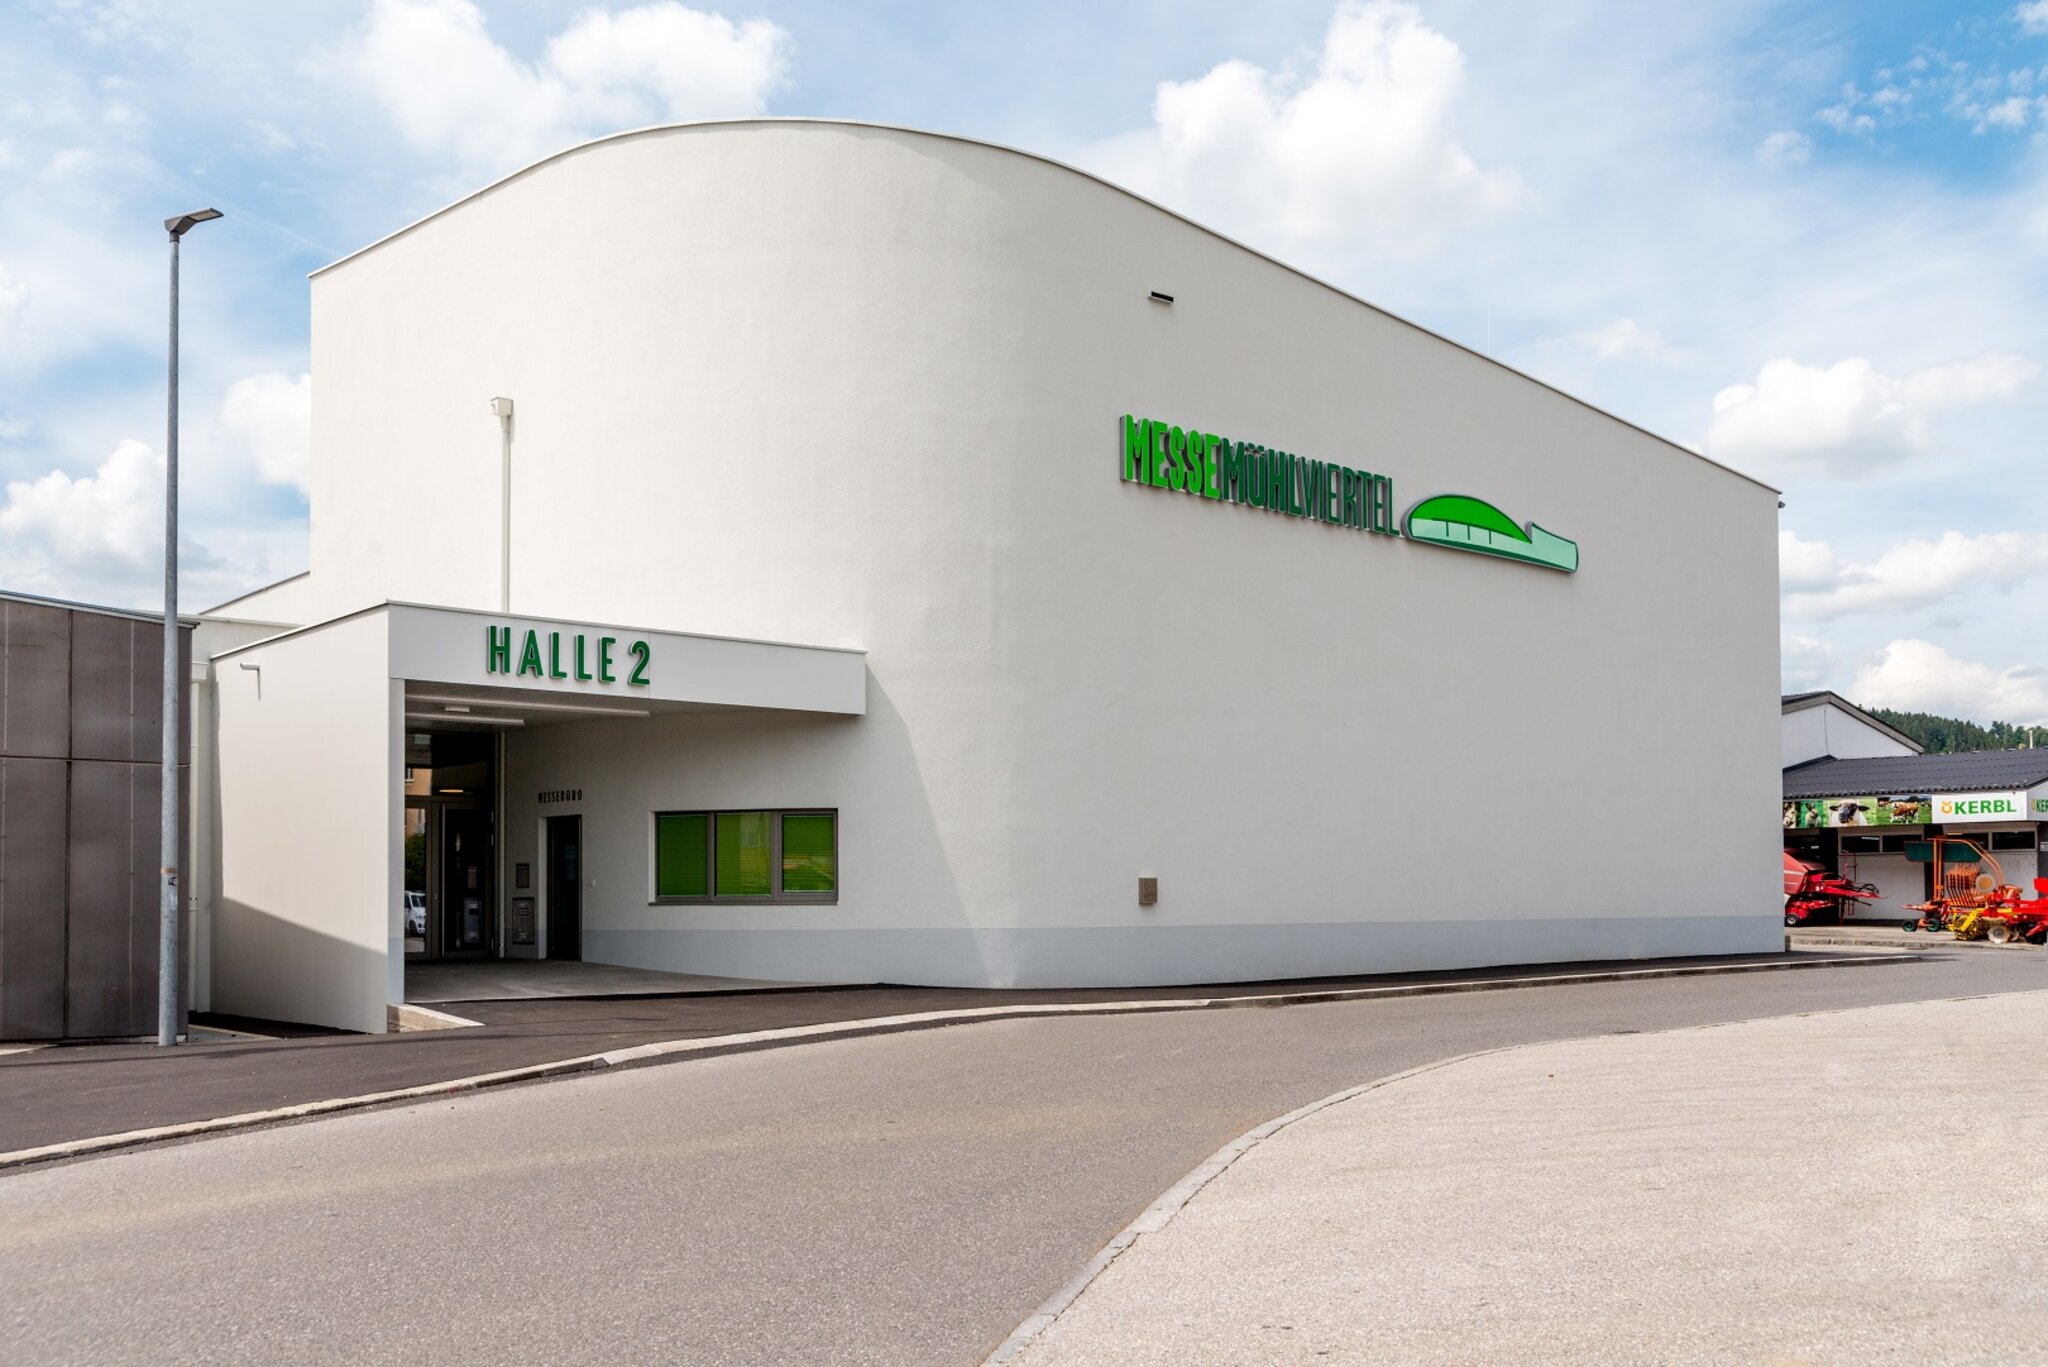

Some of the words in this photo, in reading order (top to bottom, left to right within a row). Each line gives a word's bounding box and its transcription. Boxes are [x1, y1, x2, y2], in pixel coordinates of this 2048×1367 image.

[488, 625, 616, 683] HALLE
[628, 640, 651, 686] 2
[538, 789, 583, 804] MESSEBÜRO
[1954, 799, 2016, 815] KERBL
